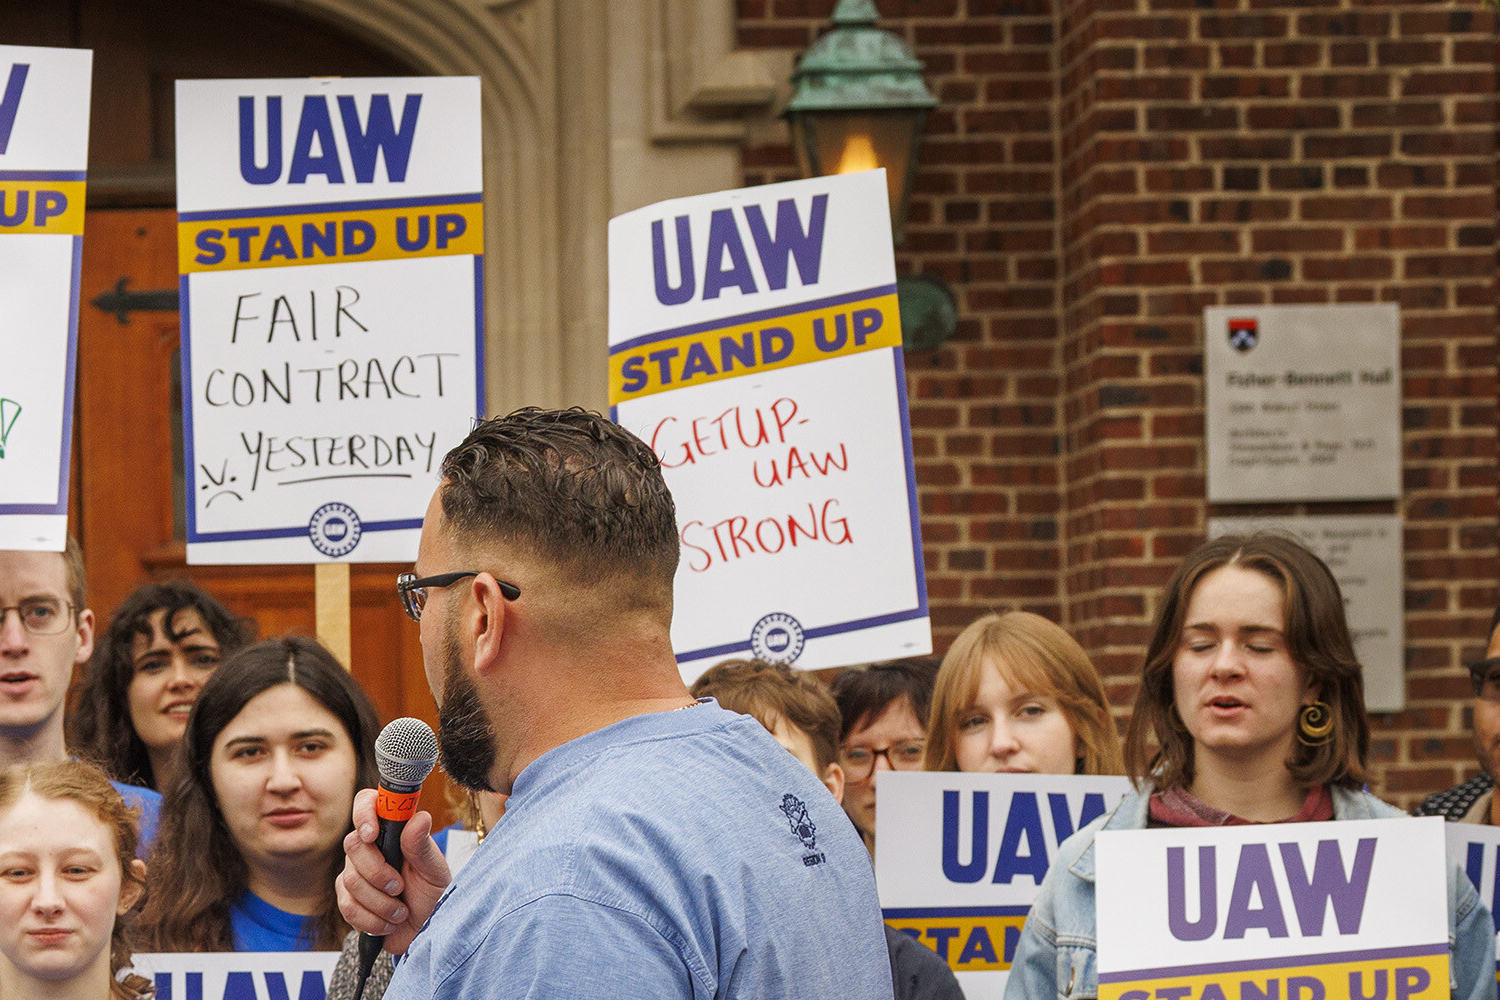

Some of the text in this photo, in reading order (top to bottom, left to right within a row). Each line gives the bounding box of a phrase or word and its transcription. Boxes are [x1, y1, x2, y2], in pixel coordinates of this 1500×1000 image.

[237, 93, 423, 186] UAW
[193, 213, 468, 266] STAND UP
[650, 193, 830, 307] UAW
[231, 285, 369, 344] FAIR
[204, 353, 460, 408] CONTRACT
[619, 307, 885, 394] STAND UP
[240, 431, 436, 492] YESTERDAY
[753, 442, 848, 488] UAW
[322, 520, 348, 538] UAW
[681, 498, 854, 573] STRONG
[1167, 838, 1377, 942] UAW
